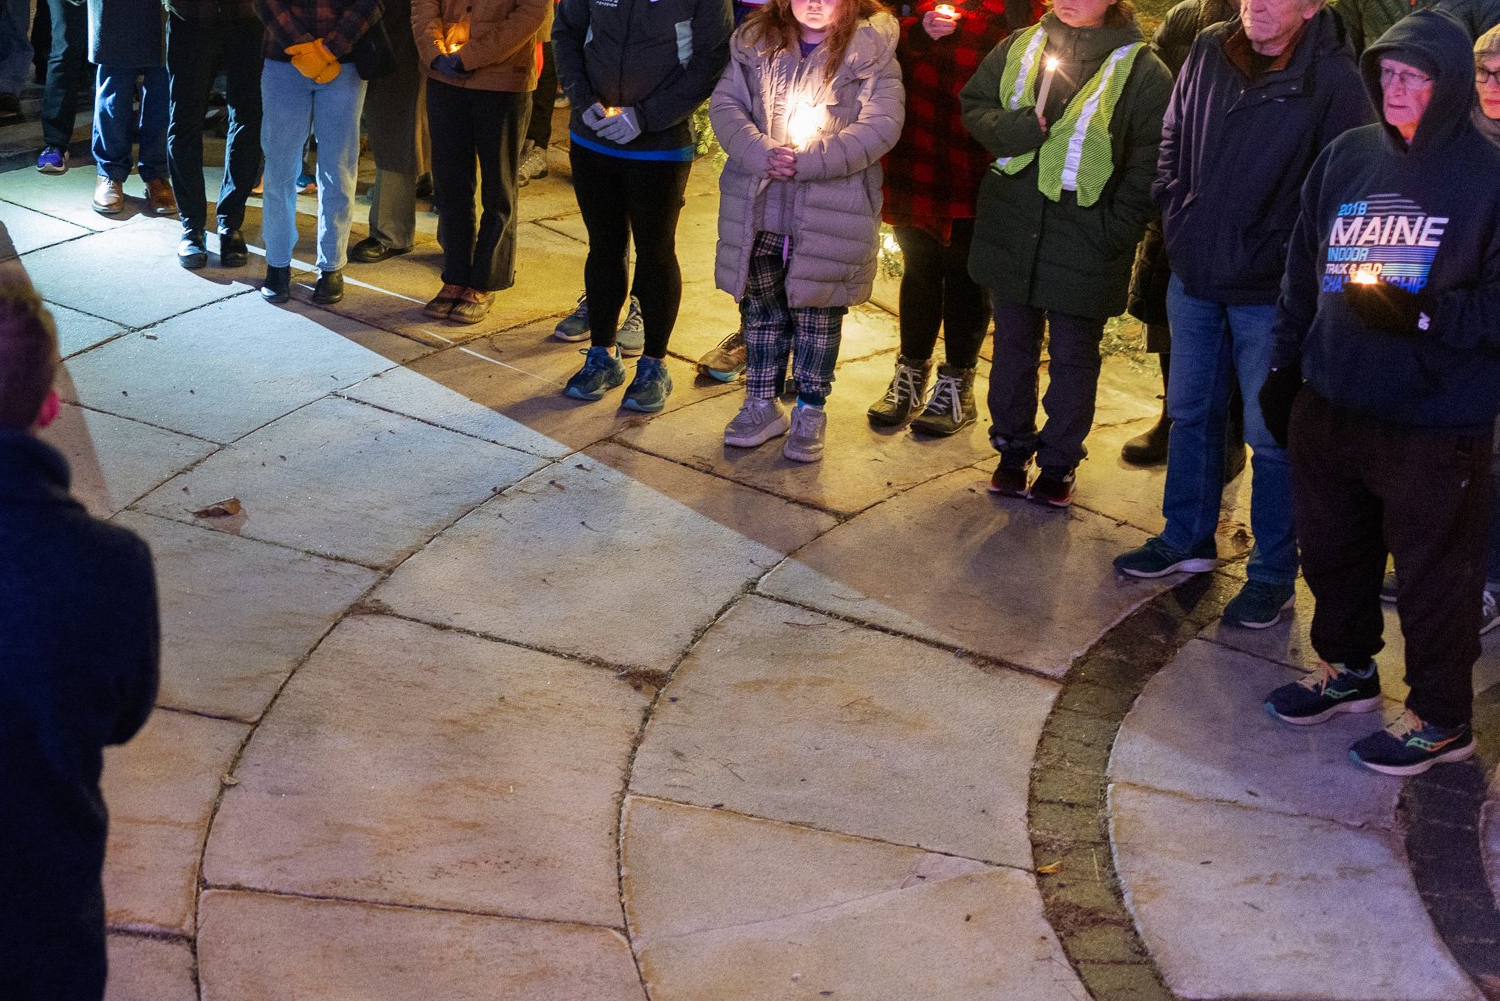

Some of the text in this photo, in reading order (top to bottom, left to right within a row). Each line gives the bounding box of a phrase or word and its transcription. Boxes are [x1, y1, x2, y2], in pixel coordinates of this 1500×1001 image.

[1338, 202, 1368, 216] 2018
[1329, 215, 1450, 247] MAINE
[1328, 247, 1369, 262] INDOOR
[1325, 263, 1350, 275] TRACK
